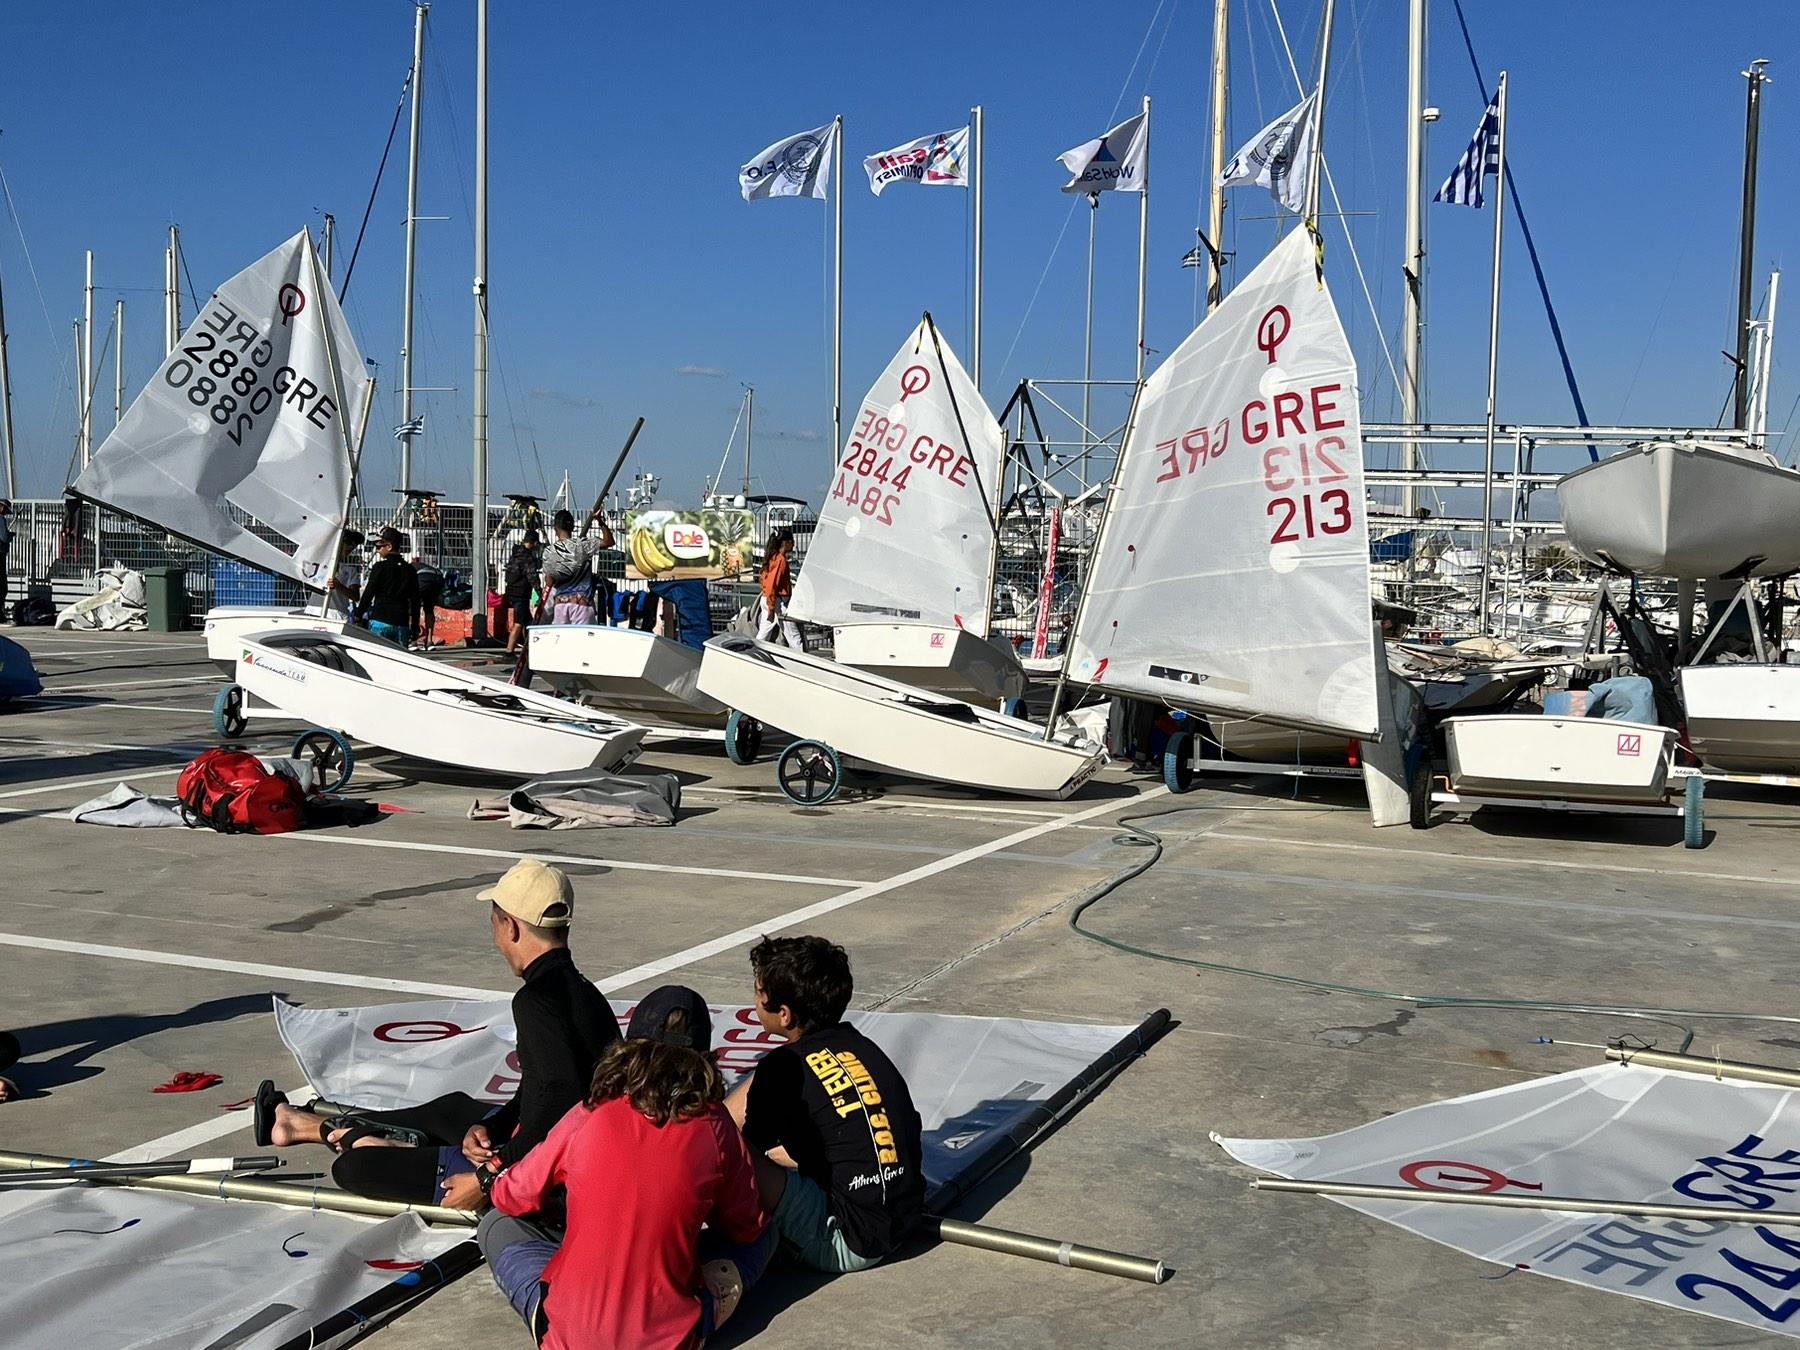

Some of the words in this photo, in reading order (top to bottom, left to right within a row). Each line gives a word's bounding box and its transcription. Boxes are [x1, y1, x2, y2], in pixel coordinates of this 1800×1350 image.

[183, 332, 273, 415] 2880
[272, 365, 338, 430] GRE
[1241, 383, 1346, 445] GRE
[842, 441, 913, 493] 2844
[909, 435, 976, 488] GRE
[673, 530, 704, 546] Dole
[1266, 489, 1352, 544] 213
[835, 1051, 882, 1106] CLINIC
